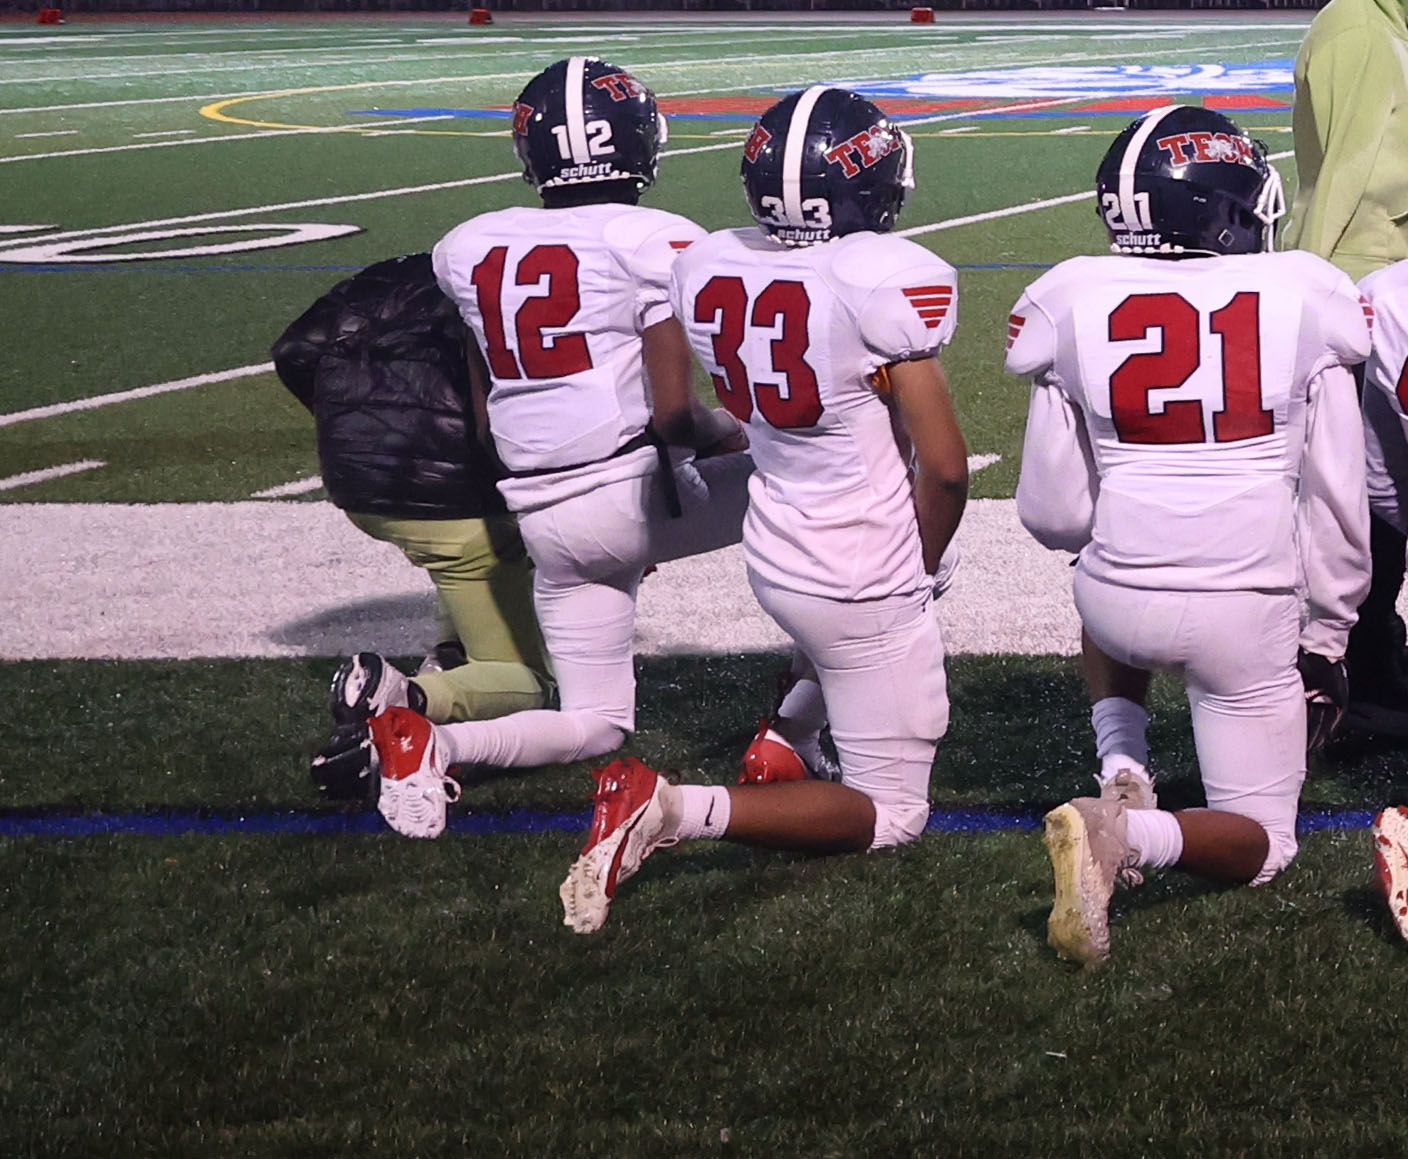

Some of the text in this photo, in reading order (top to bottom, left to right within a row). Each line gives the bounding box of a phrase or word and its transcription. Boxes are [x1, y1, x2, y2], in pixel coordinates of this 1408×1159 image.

[551, 119, 616, 160] 12
[560, 161, 612, 179] schutt
[761, 195, 833, 230] 33
[1102, 191, 1154, 231] 21
[776, 228, 832, 241] schutt
[1115, 231, 1162, 246] schutt
[471, 243, 593, 380] 12
[694, 275, 826, 429] 33
[1107, 291, 1276, 444] 21
